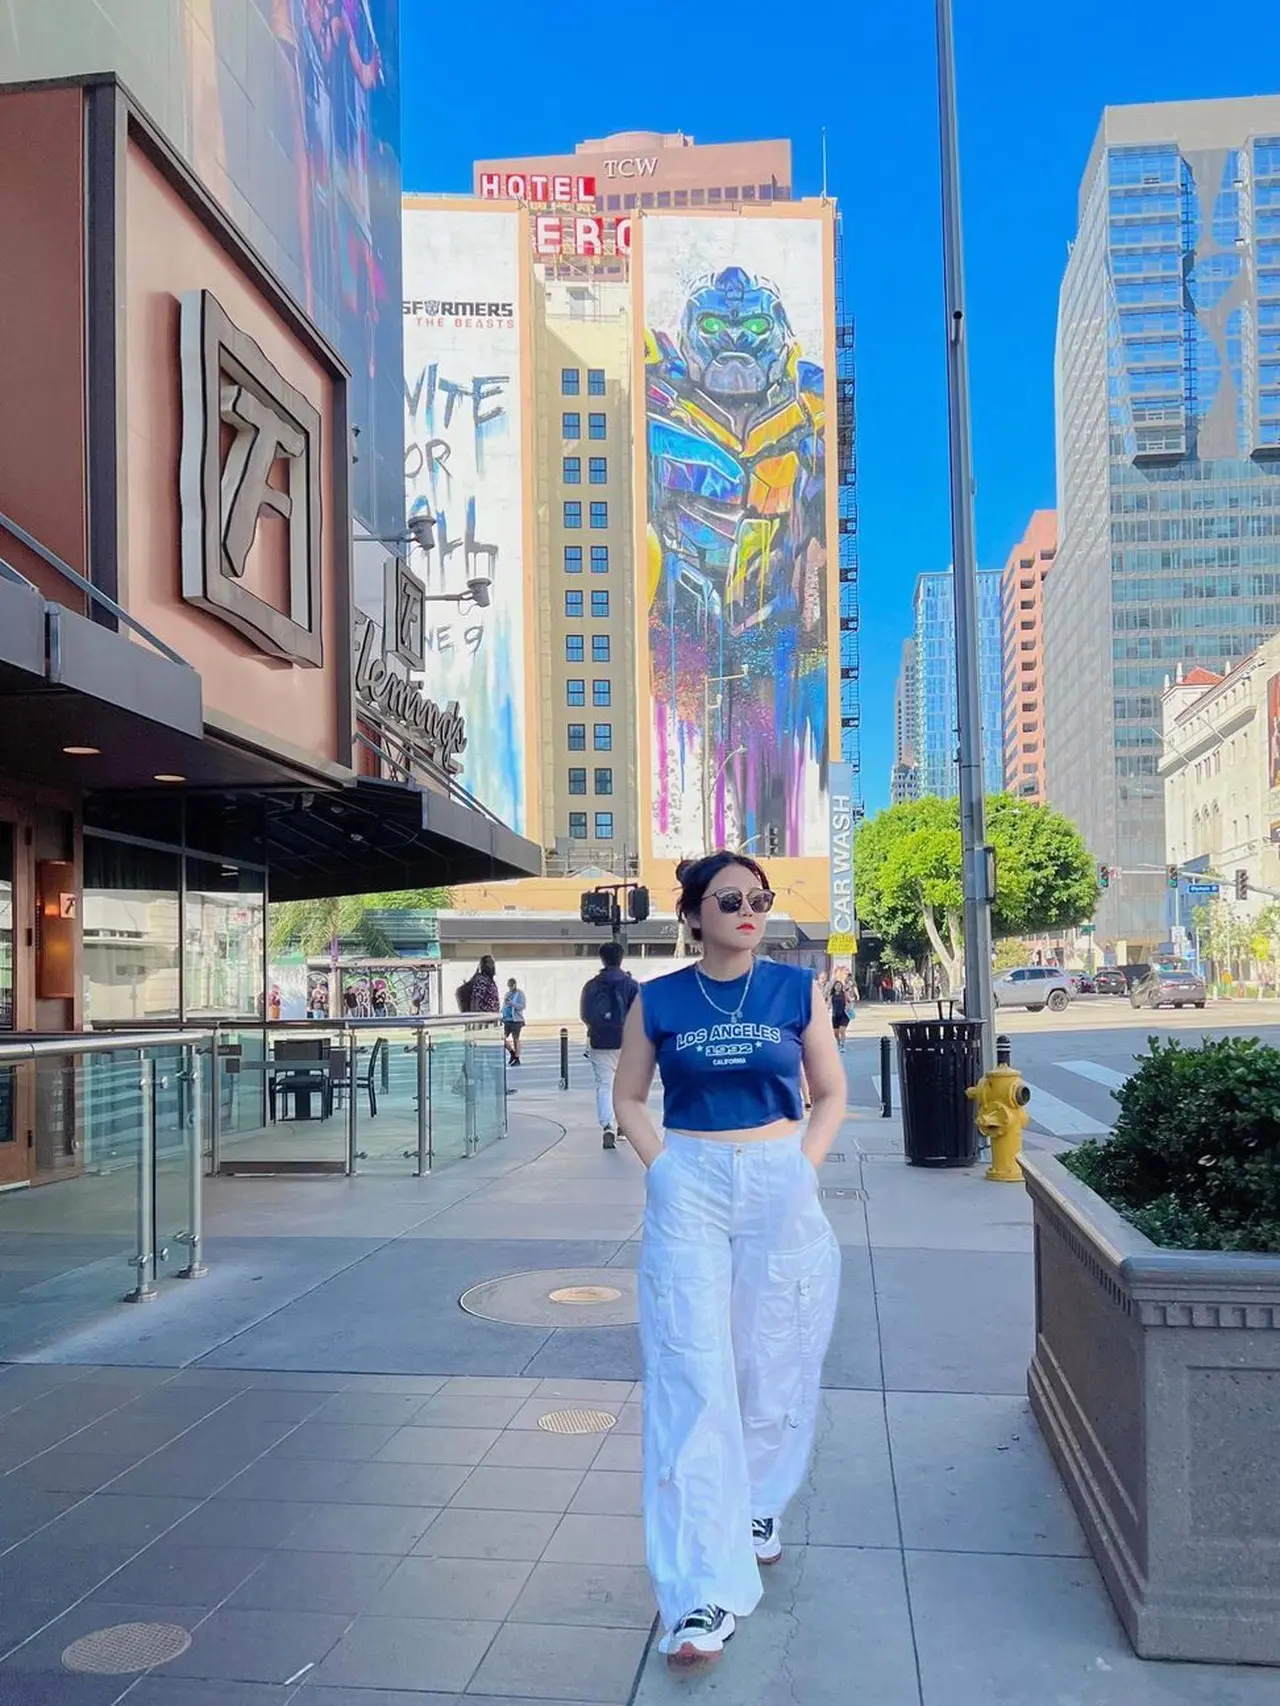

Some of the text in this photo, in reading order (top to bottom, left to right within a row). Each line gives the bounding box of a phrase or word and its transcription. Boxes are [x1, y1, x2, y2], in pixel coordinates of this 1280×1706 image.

[604, 157, 658, 178] TCW
[481, 174, 596, 201] HOTEL
[416, 317, 514, 329] THE BEASTS
[404, 439, 452, 478] OR
[832, 794, 851, 875] WASH
[832, 880, 852, 934] CAR
[676, 1022, 782, 1051] LOS ANGELES
[712, 1057, 747, 1066] CALIFORNIA
